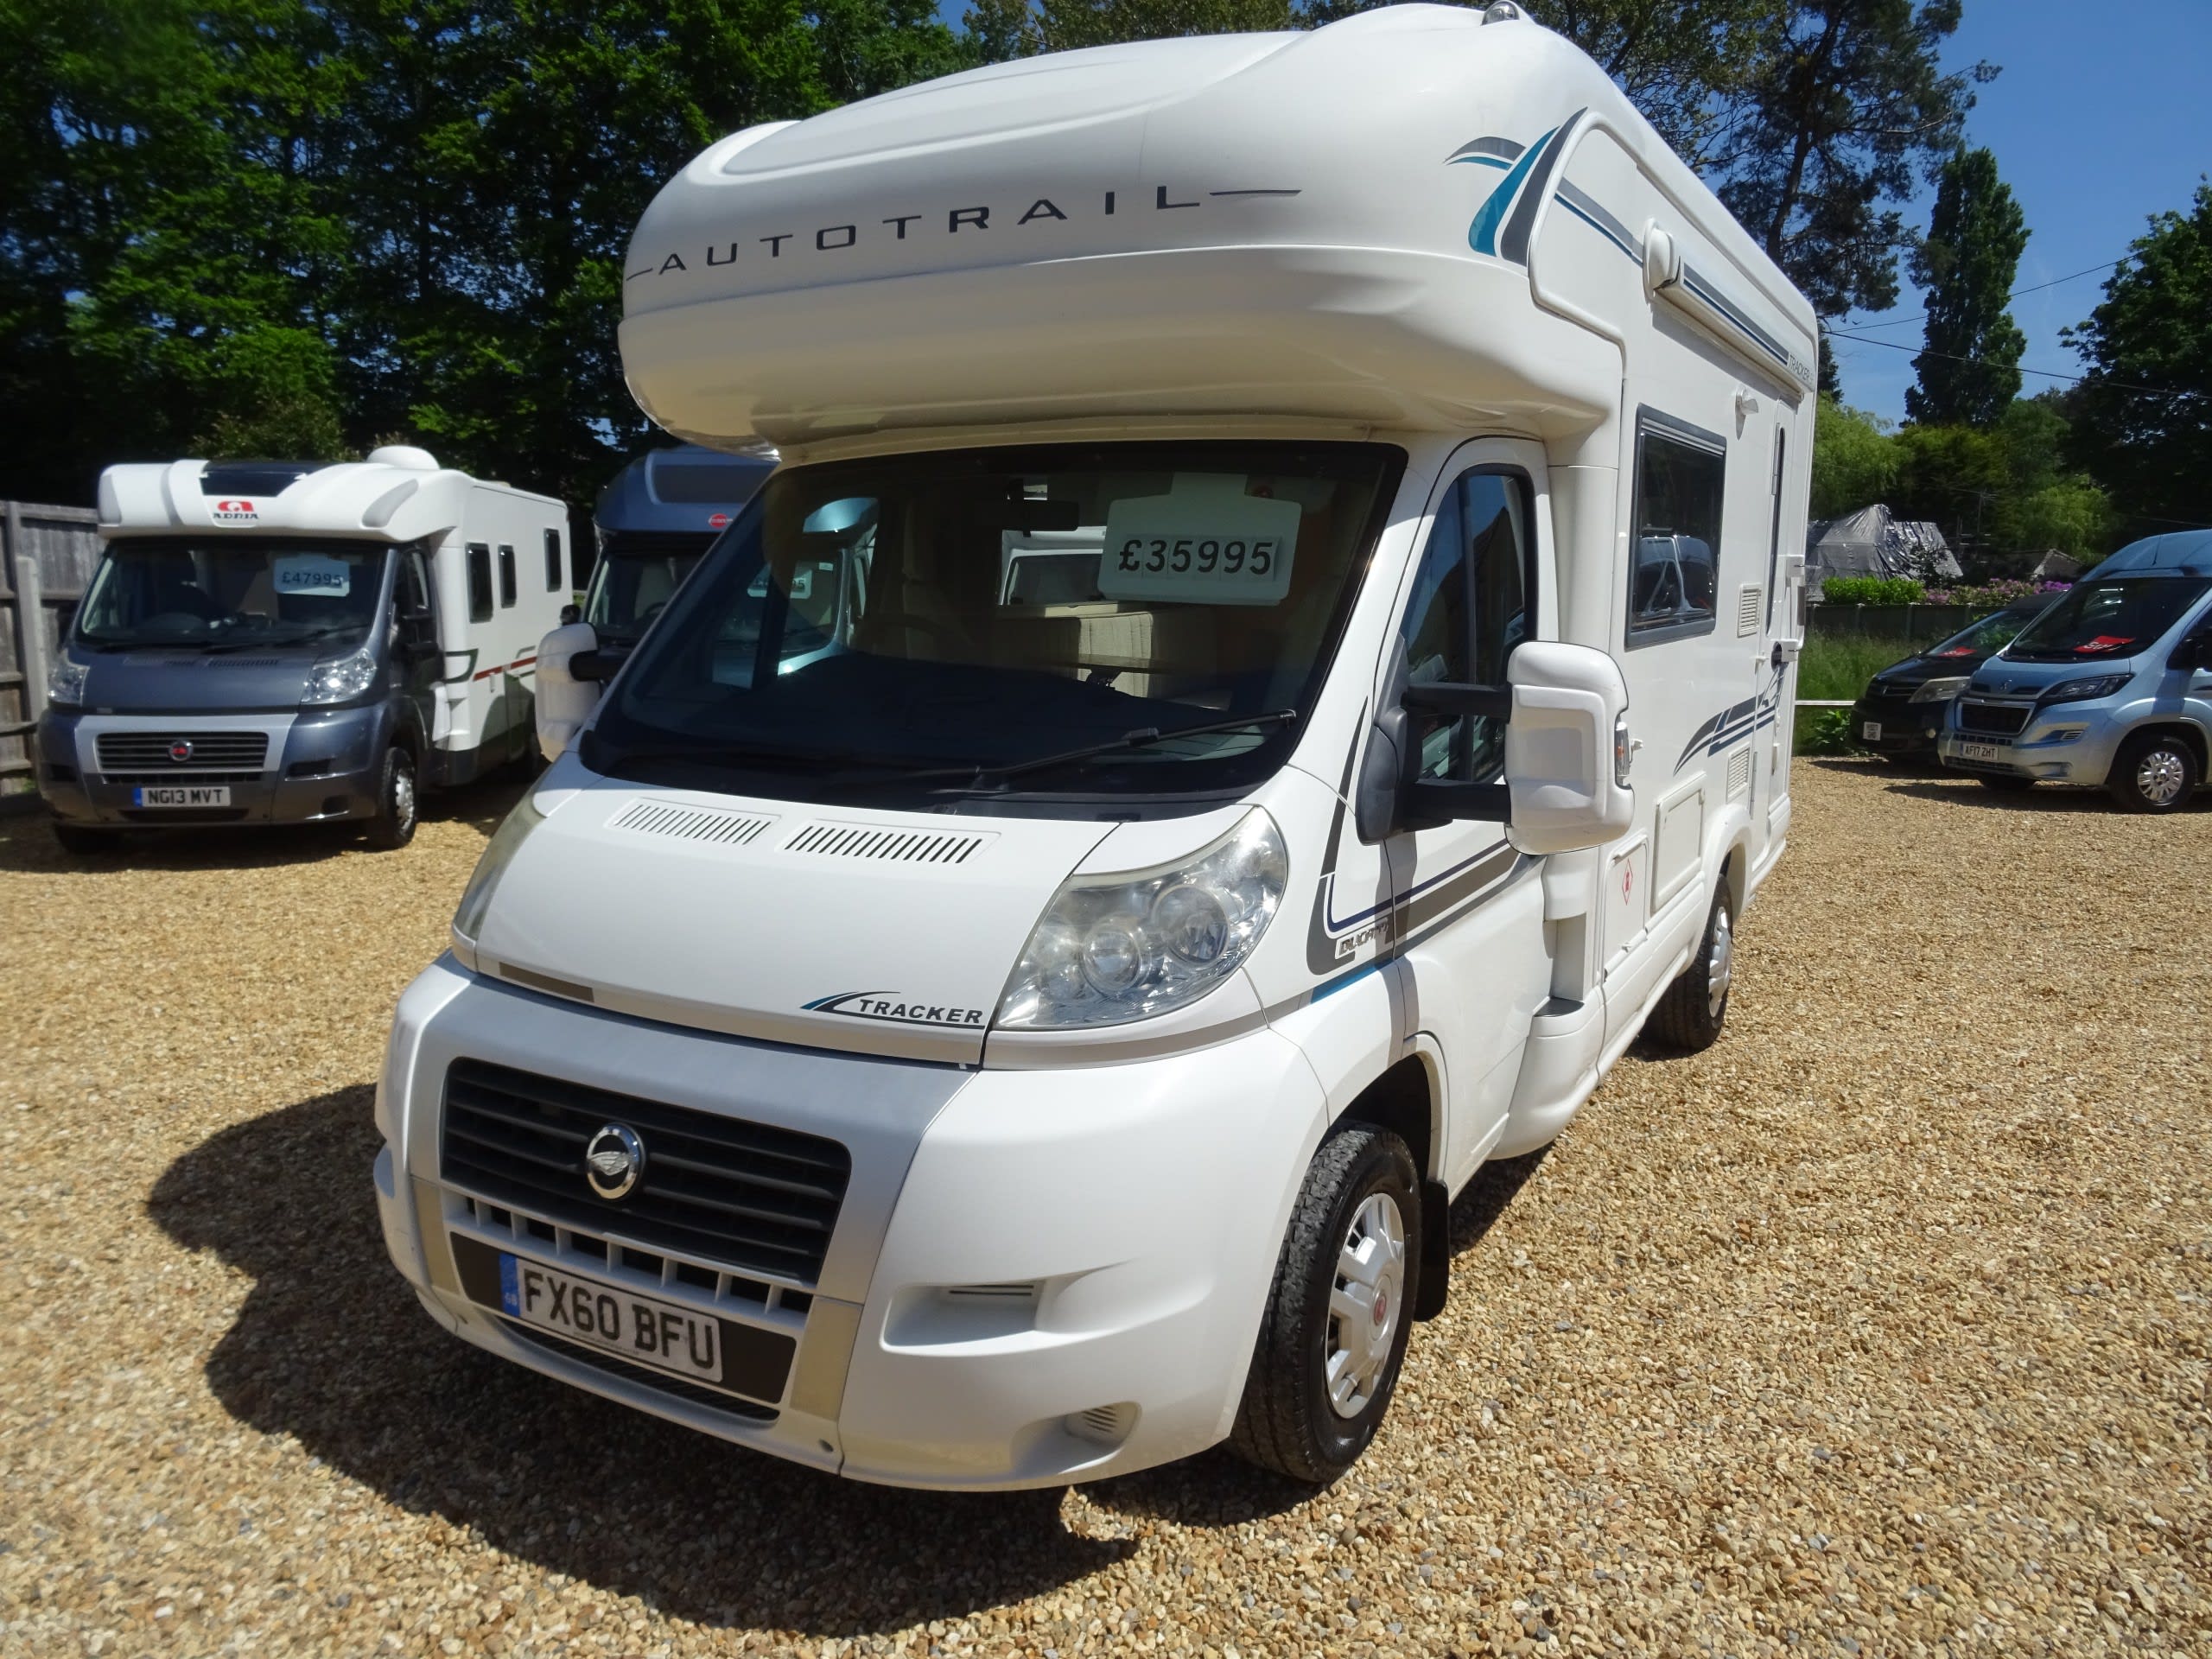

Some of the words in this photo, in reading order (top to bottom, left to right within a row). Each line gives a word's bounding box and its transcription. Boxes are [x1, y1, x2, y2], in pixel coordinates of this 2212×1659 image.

[658, 186, 1200, 275] AUTOTRAIL
[1119, 539, 1273, 575] £35995
[282, 571, 344, 588] £47995
[1965, 745, 1980, 756] AF17
[148, 790, 186, 804] NG13
[191, 789, 223, 804] MVT
[857, 999, 983, 1024] TRACKER
[524, 1268, 620, 1341] FX60
[632, 1304, 715, 1370] BFU
